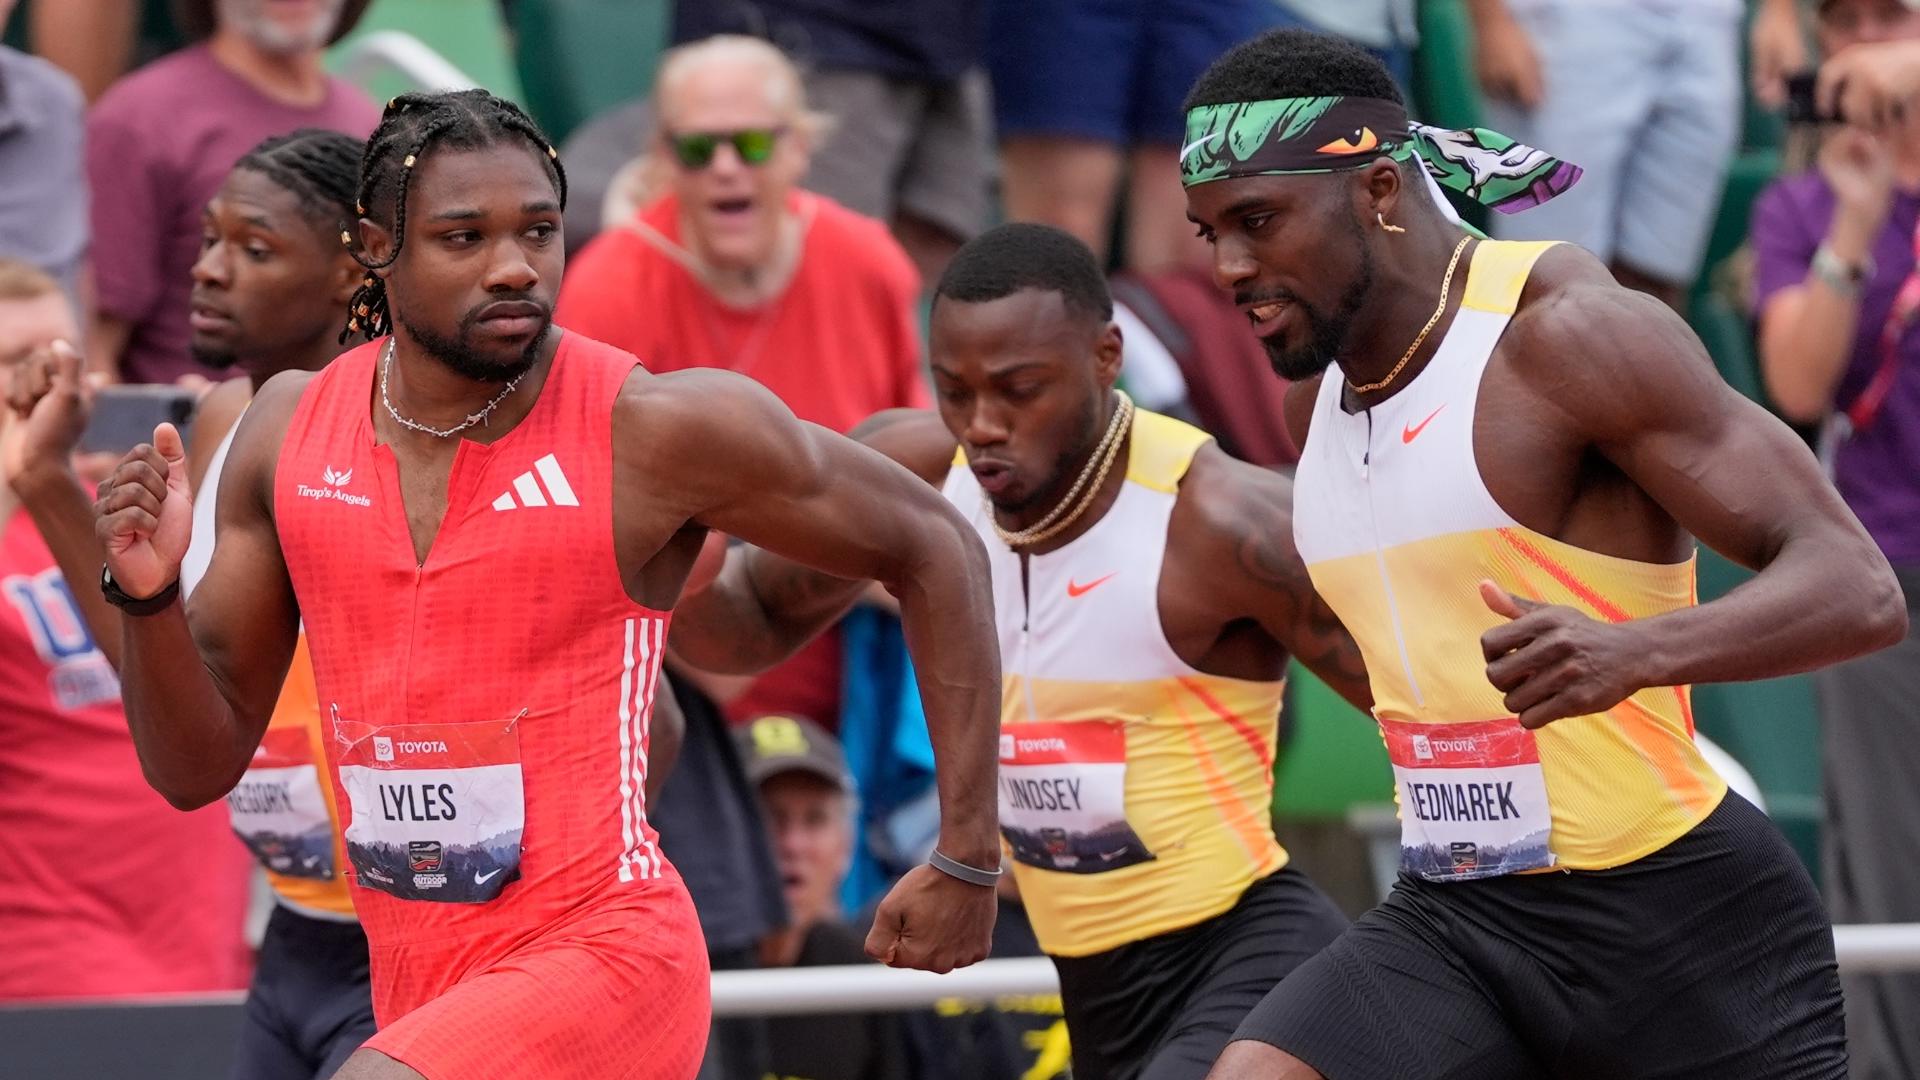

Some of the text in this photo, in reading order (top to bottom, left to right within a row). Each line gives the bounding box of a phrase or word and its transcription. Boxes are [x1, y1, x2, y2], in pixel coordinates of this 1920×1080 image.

[297, 484, 371, 507] Tirop's Angels
[397, 741, 448, 753] TOYOTA
[1017, 738, 1066, 753] TOYOTA
[1432, 740, 1476, 752] TOYOTA
[379, 783, 457, 821] LYLES
[1407, 781, 1521, 822] BEDNAREK
[413, 876, 447, 884] OUTDOOR
